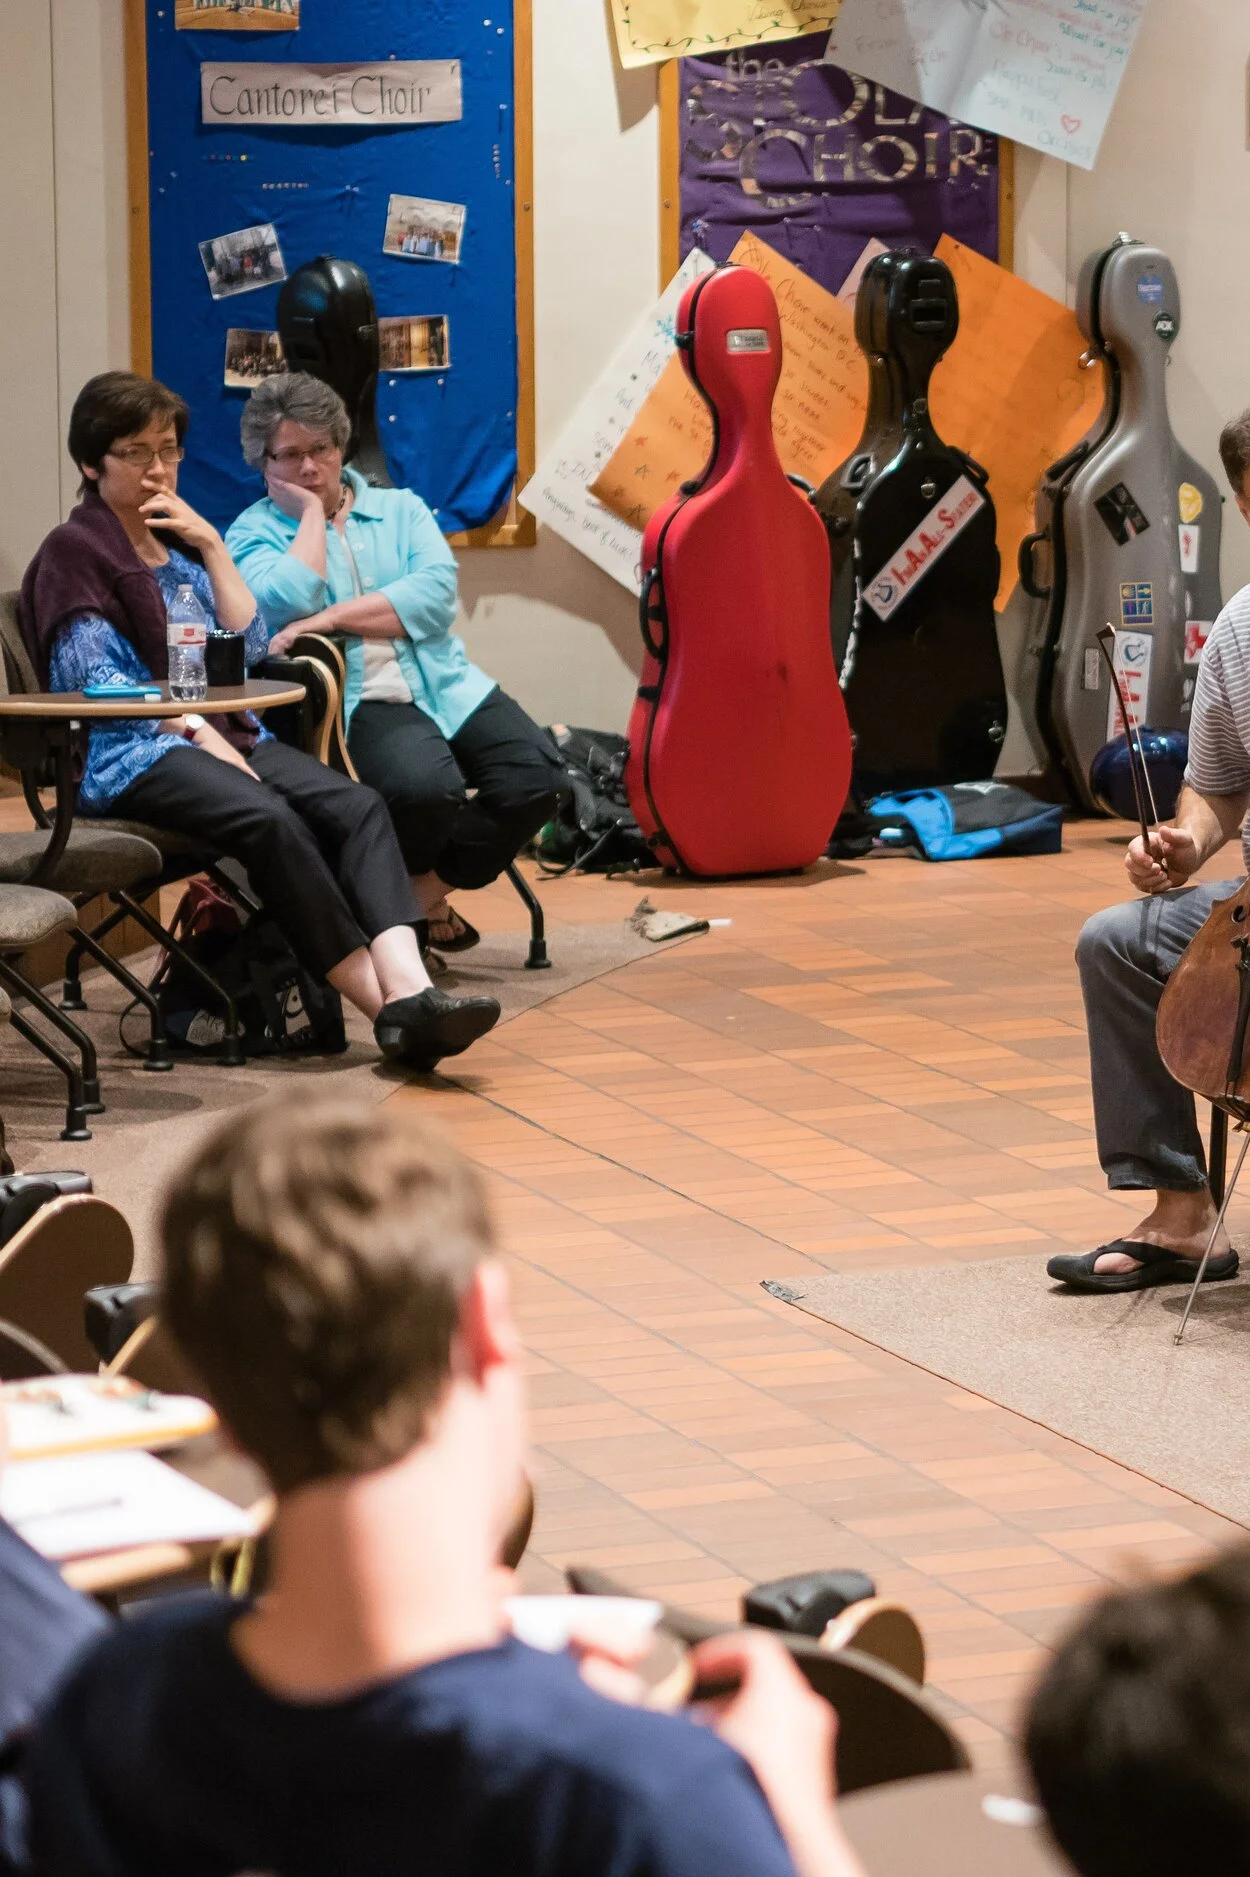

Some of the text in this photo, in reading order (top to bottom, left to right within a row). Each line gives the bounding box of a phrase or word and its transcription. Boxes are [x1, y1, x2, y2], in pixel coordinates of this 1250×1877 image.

[209, 75, 432, 117] Cantorei Choir
[738, 127, 991, 209] CHOIR
